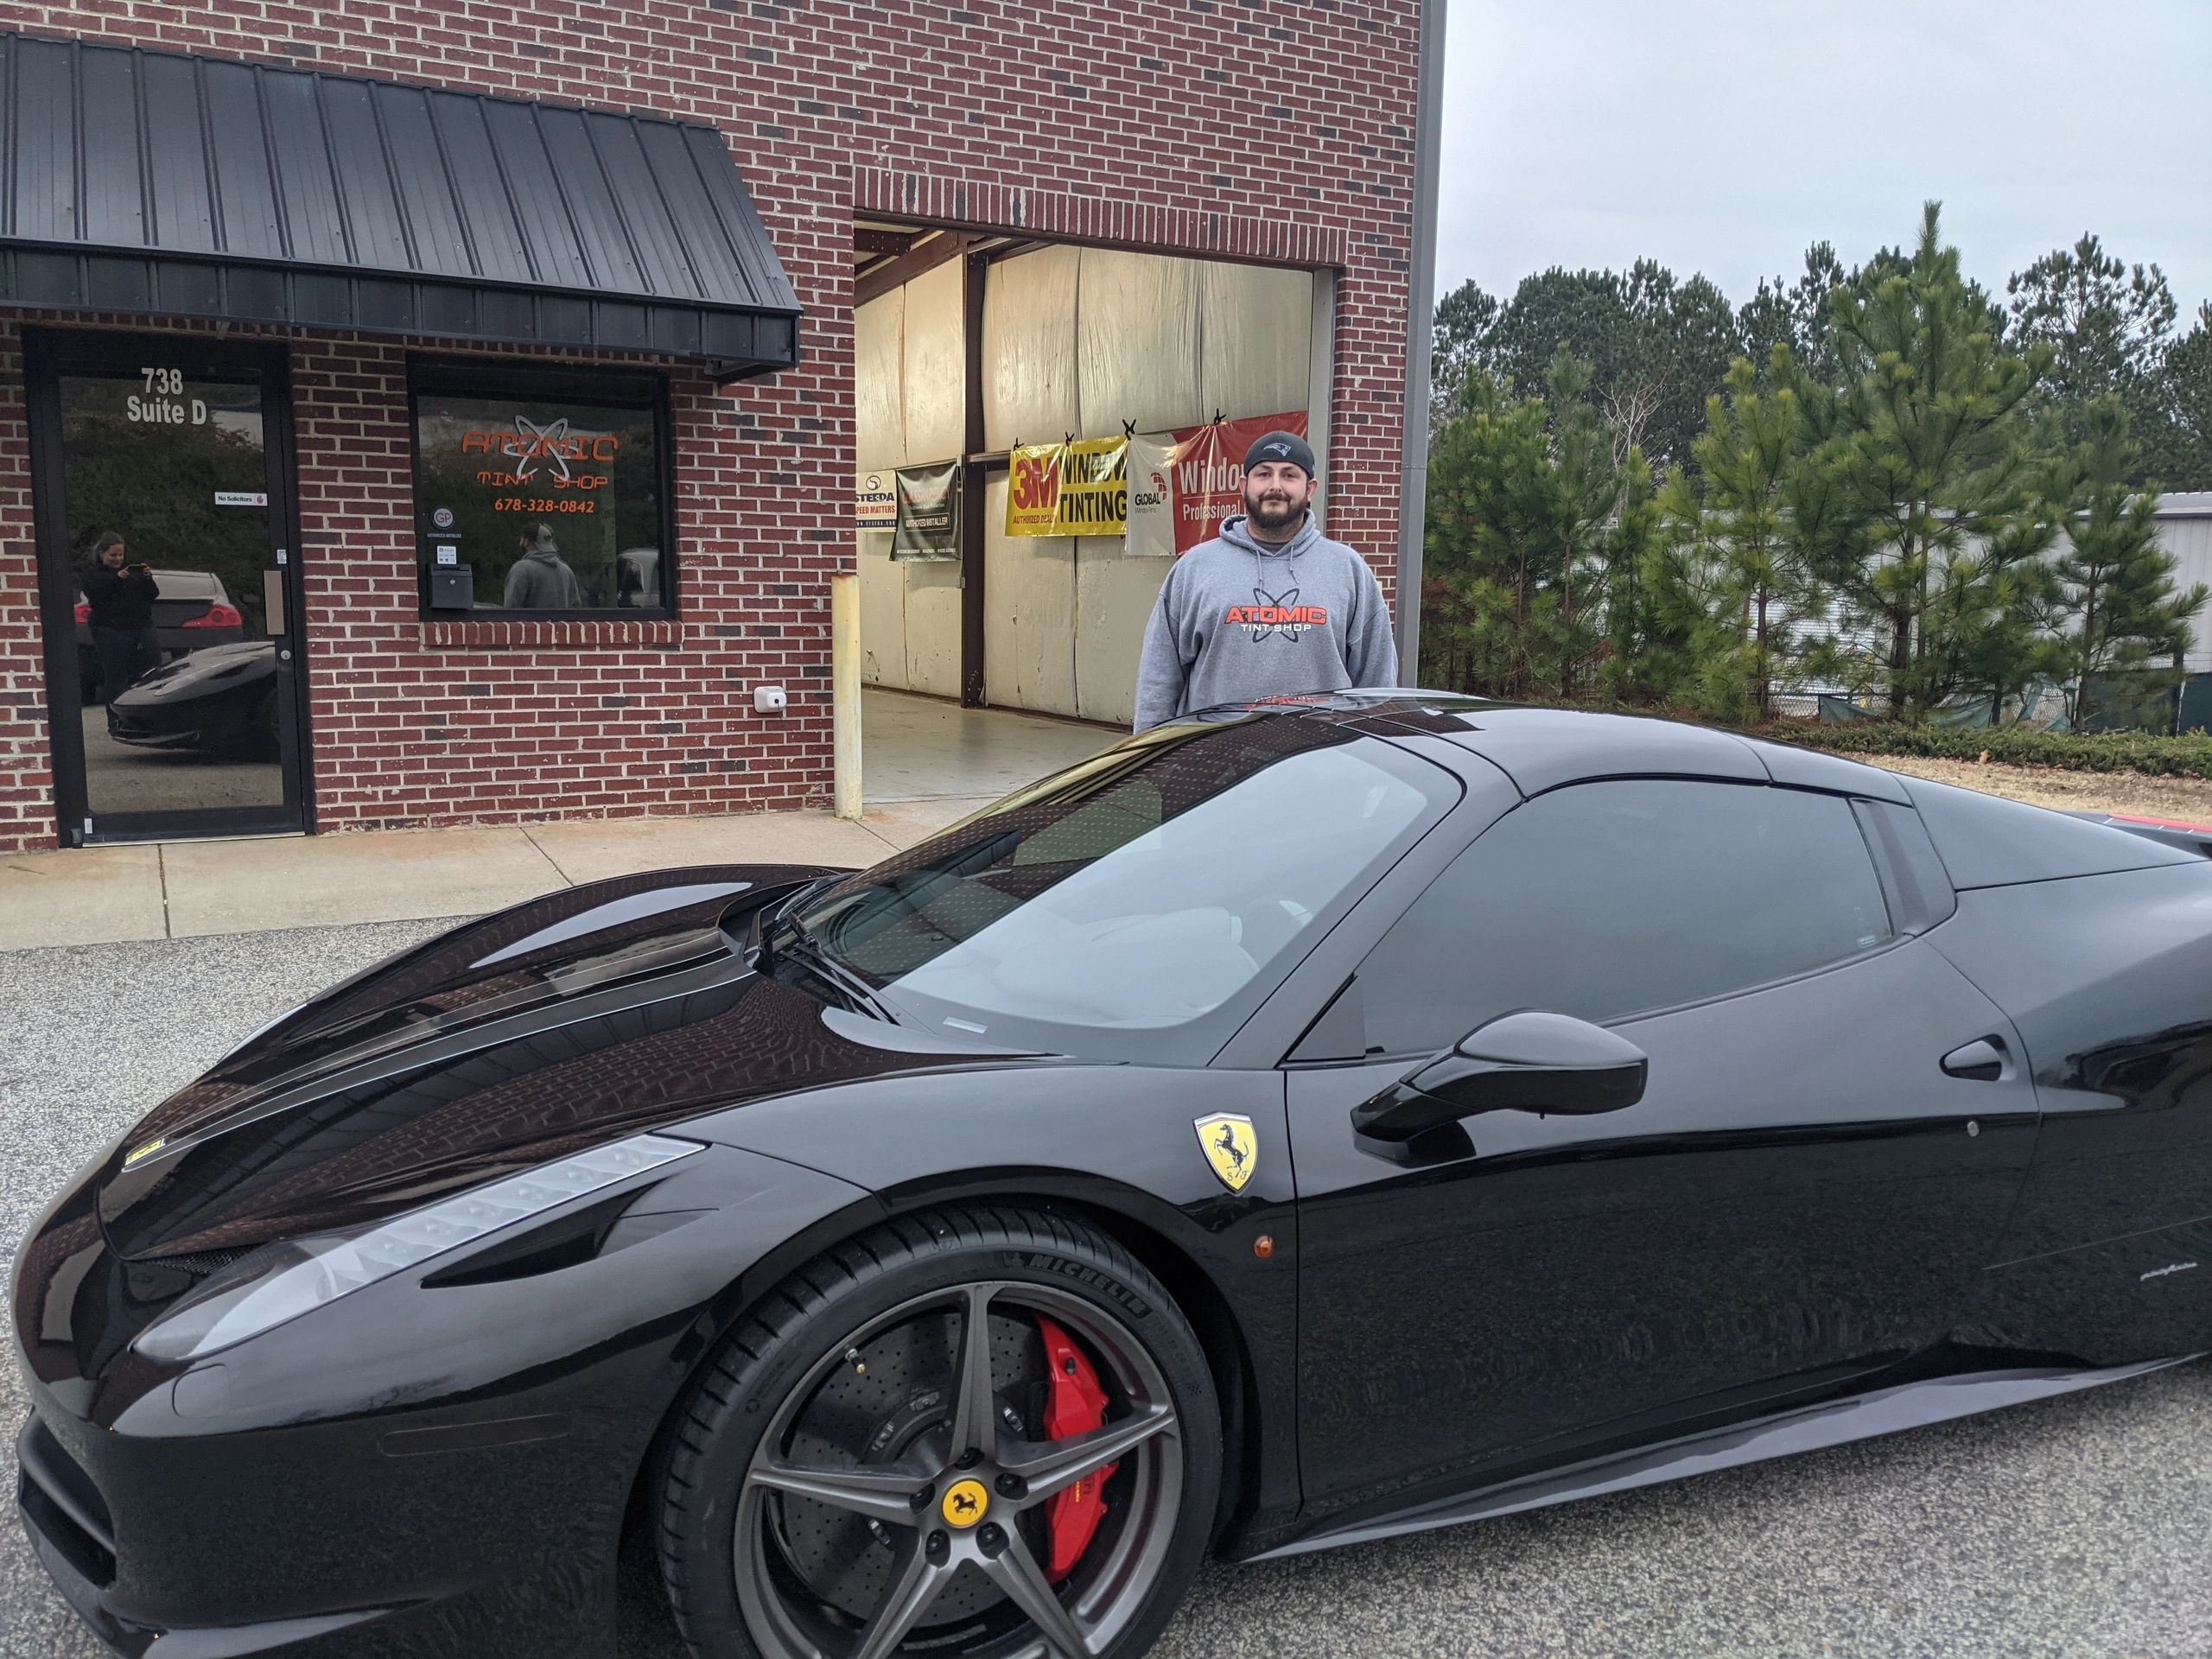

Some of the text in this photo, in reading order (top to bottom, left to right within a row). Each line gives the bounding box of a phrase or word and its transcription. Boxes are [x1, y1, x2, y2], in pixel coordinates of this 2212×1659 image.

[141, 367, 184, 395] 738
[127, 396, 207, 425] Suite D
[461, 431, 619, 461] ATOMIC
[477, 471, 608, 489] TINT SHOP
[1013, 456, 1058, 510] 3M
[1178, 457, 1244, 495] Windo
[494, 498, 594, 513] 678-328-0842
[856, 505, 895, 514] PEED MATTERS
[1059, 490, 1128, 523] TINTING
[1135, 493, 1161, 505] GLOBAL
[1183, 499, 1241, 520] Professional
[435, 512, 452, 523] GP
[1224, 606, 1327, 625] ATOMIC
[1241, 624, 1312, 632] TINT SHOP
[1029, 1254, 1147, 1318] MICHELIN
